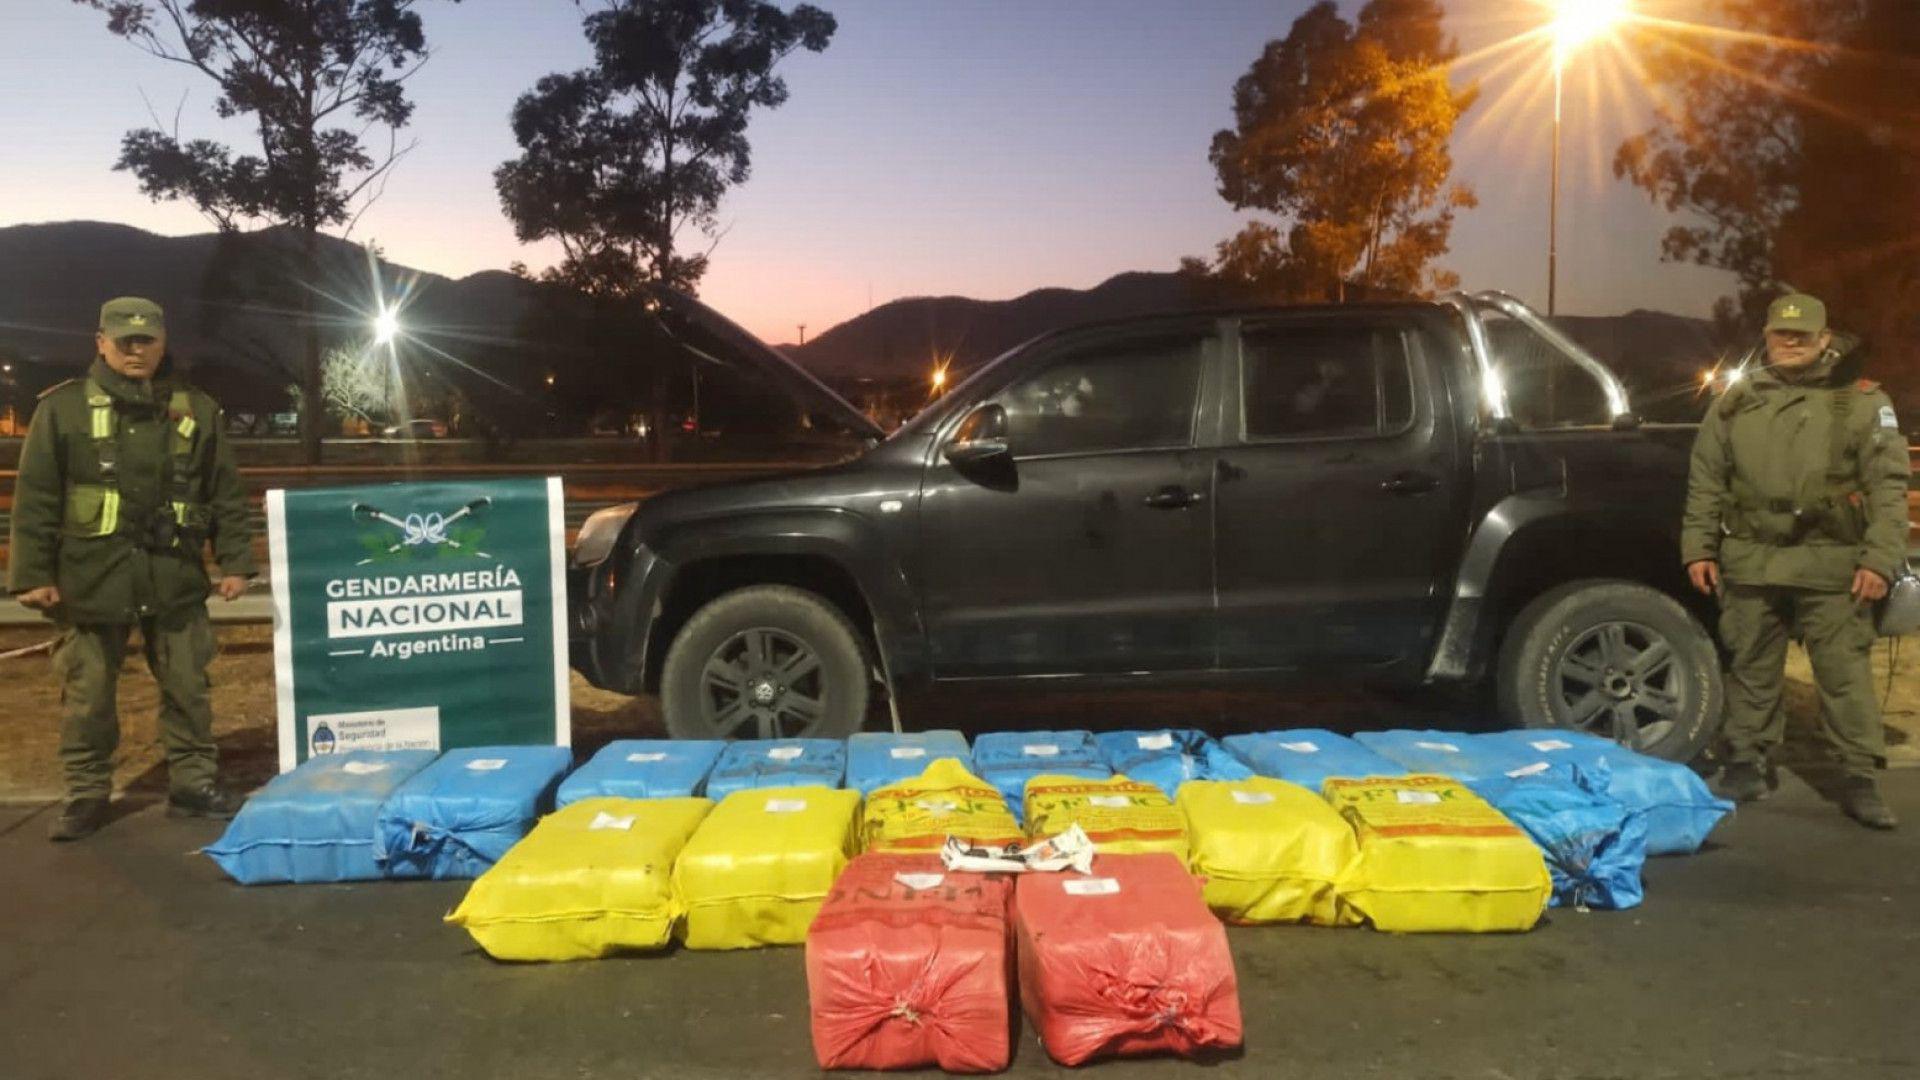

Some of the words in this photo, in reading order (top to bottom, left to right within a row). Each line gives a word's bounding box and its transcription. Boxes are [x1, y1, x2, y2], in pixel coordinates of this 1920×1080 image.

[326, 565, 521, 598] GENDARMERÍA
[340, 599, 512, 629] NACIONAL
[370, 634, 485, 659] Argentina
[338, 728, 386, 742] Seguridad
